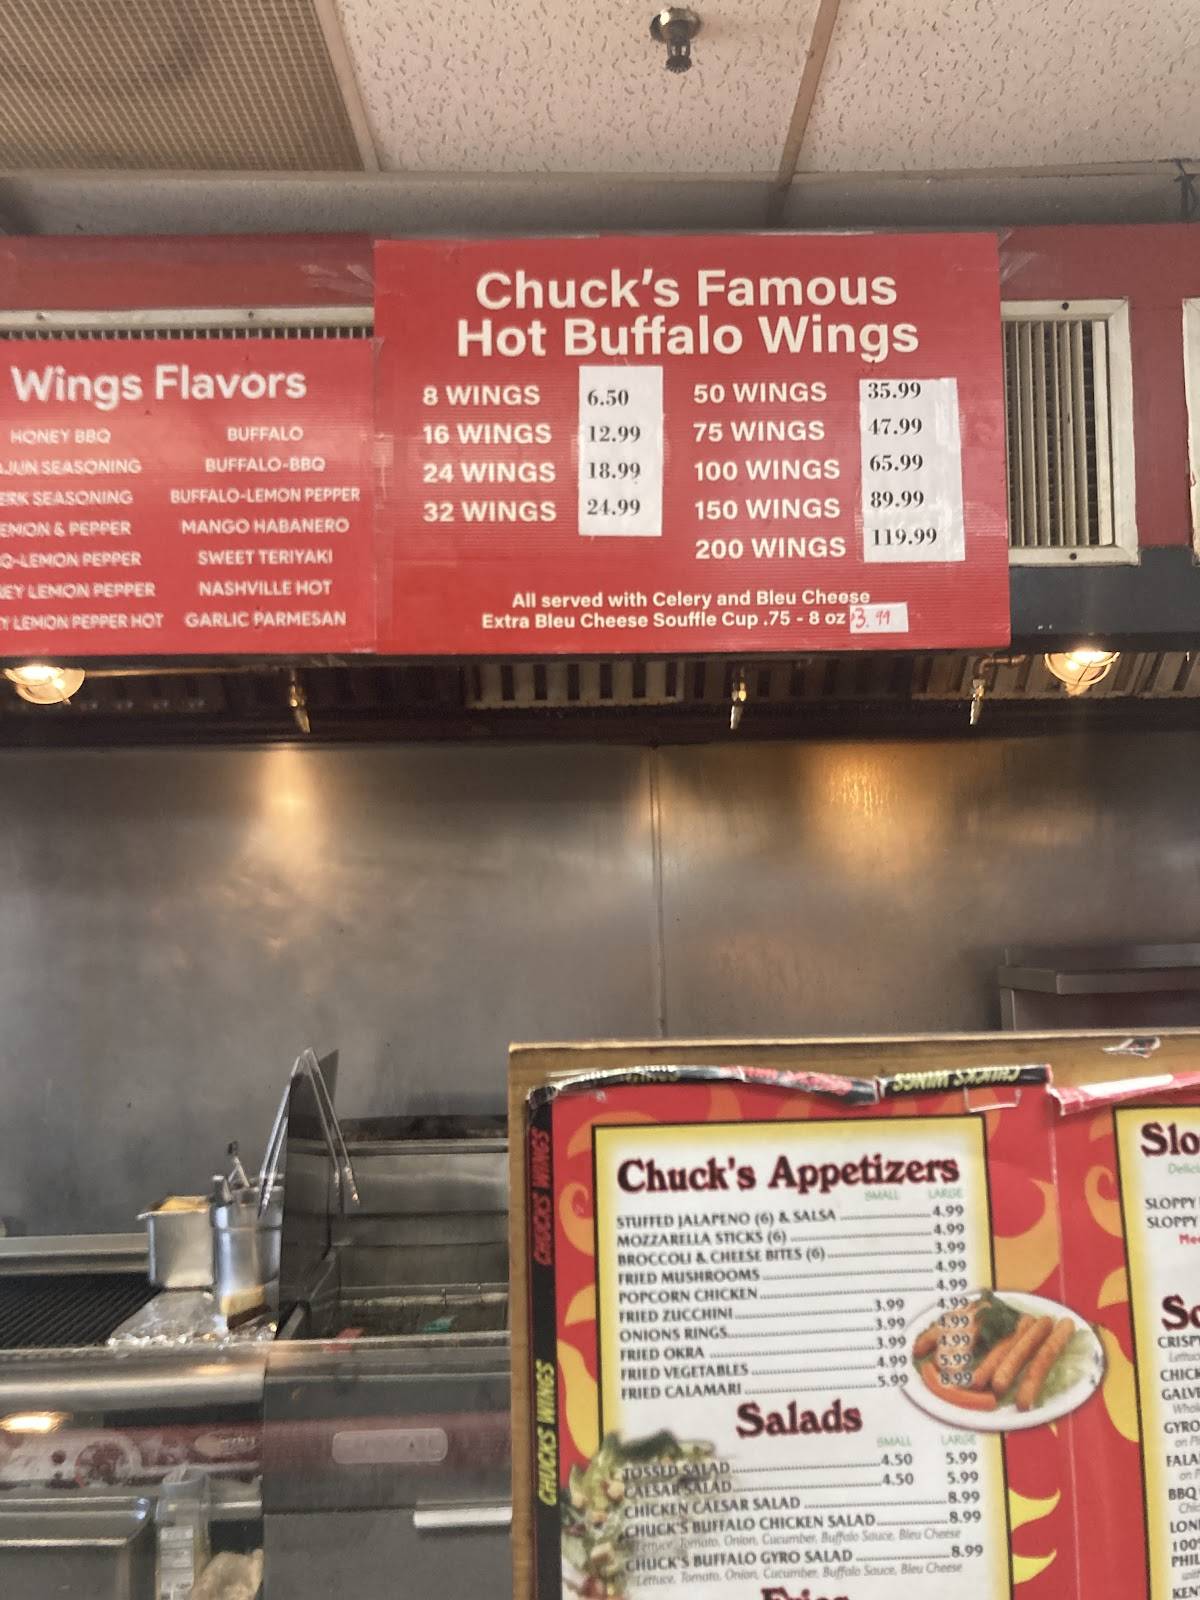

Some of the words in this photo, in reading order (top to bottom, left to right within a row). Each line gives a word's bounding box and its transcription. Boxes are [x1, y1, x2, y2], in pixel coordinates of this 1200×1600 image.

[476, 268, 680, 310] Chuck's
[697, 268, 898, 307] Famous
[457, 318, 547, 357] Hot
[563, 315, 743, 356] Buffalo
[758, 314, 920, 364] Wings
[11, 365, 143, 411] Wings
[155, 364, 307, 400] Flavors
[422, 385, 439, 406] 8
[446, 385, 541, 405] WINGS
[693, 384, 725, 404] 50
[733, 382, 828, 403] WINGS
[867, 381, 922, 399] 35.99
[587, 389, 629, 407] 6.50
[227, 426, 304, 442] BUFFALO
[423, 424, 450, 444] 16
[457, 423, 552, 444] WINGS
[587, 425, 641, 443] 12.99
[693, 422, 723, 442] 75
[731, 420, 825, 441] WINGS
[868, 417, 923, 435] 47.99
[10, 428, 70, 445] HONEY
[74, 428, 112, 444] BBQ
[42, 457, 142, 475] SEASONING
[205, 457, 326, 473] BUFFALO-BBQ
[587, 461, 641, 479] 18.99
[694, 461, 738, 481] 100
[746, 459, 841, 480] WINGS
[869, 453, 924, 472] 65.99
[423, 463, 454, 483] 24
[461, 462, 556, 483] WINGS
[33, 489, 133, 506] SEASONING
[170, 488, 302, 504] BUFFALO-LEMON
[304, 487, 361, 502] PEPPER
[870, 490, 925, 508] 89.99
[423, 502, 454, 522] 32
[461, 501, 557, 522] WINGS
[586, 498, 641, 516] 24.99
[694, 500, 738, 520] 150
[746, 498, 841, 519] WINGS
[54, 521, 65, 537] &
[69, 520, 131, 536] PEPPER
[182, 519, 250, 535] MANGO
[254, 517, 349, 534] HABANERO
[871, 528, 938, 547] 119.99
[198, 550, 254, 566] SWEET
[258, 549, 332, 564] TERIYAKI
[695, 539, 744, 560] 200
[752, 537, 846, 559] WINGS
[82, 550, 142, 567] PEPPER
[28, 582, 90, 599] LEMON
[93, 581, 156, 598] PEPPER
[199, 581, 292, 597] NASHVILLE
[296, 580, 333, 595] HOT
[512, 592, 536, 608] All
[541, 592, 604, 608] served
[608, 591, 648, 607] with
[652, 590, 712, 609] Celery
[717, 590, 751, 606] and
[756, 589, 797, 606] Bleu
[801, 589, 870, 605] Cheese
[13, 613, 68, 631] LEMON
[72, 612, 128, 629] PEPPER
[131, 612, 164, 628] HOT
[185, 611, 249, 628] GARLIC
[254, 611, 347, 627] PARMESAN
[482, 614, 530, 629] Extra
[535, 613, 576, 629] Bleu
[580, 612, 649, 628] Cheese
[653, 611, 717, 627] Souffle
[721, 611, 759, 629] Cup
[763, 611, 791, 626] .75
[808, 610, 820, 625] 8
[825, 613, 846, 625] oz
[616, 1156, 757, 1193] Chuck's
[768, 1152, 960, 1195] Appetizers
[933, 1205, 964, 1217] 4.99
[1145, 1196, 1195, 1210] SLOPPY
[616, 1214, 674, 1228] STUFFED
[678, 1212, 750, 1229] JALAPENO
[755, 1211, 774, 1227] (6)
[779, 1210, 789, 1223] &
[793, 1208, 836, 1222] SALSA
[1147, 1215, 1198, 1229] SLOPPY
[617, 1232, 711, 1247] MOZZARELLA
[716, 1230, 763, 1244] STICKS
[767, 1230, 787, 1246] (6)
[933, 1223, 965, 1236] 4.99
[618, 1251, 691, 1266] BROCCOLI
[696, 1251, 706, 1264] &
[710, 1249, 762, 1264] CHEESE
[766, 1248, 802, 1262] BITES
[806, 1246, 826, 1263] (6)
[935, 1241, 966, 1255] 3.99
[936, 1260, 967, 1273] 4.99
[618, 1271, 657, 1285] FRIED
[661, 1269, 760, 1284] MUSHROOMS
[937, 1278, 968, 1291] 4.99
[618, 1290, 690, 1305] POPCORN
[694, 1287, 757, 1302] CHICKEN
[937, 1297, 969, 1309] 4.99
[875, 1299, 905, 1312] 3.99
[619, 1309, 658, 1324] FRIED
[662, 1307, 733, 1322] ZUCCHINI
[876, 1317, 906, 1330] 3.99
[619, 1328, 680, 1343] ONIONS
[684, 1326, 728, 1340] RINGS
[876, 1336, 906, 1349] 3.99
[620, 1348, 660, 1362] FRIED
[664, 1346, 705, 1360] OKRA
[877, 1354, 908, 1368] 4.99
[621, 1367, 660, 1381] FRIED
[664, 1363, 749, 1379] VEGETABLES
[877, 1374, 909, 1388] 5.99
[536, 1358, 555, 1424] WINGS
[621, 1386, 661, 1400] FRIED
[665, 1382, 742, 1398] CALAMARI
[736, 1398, 863, 1438] Salads
[537, 1425, 557, 1505] CHUCKS
[881, 1453, 913, 1466] 4.50
[946, 1451, 978, 1465] 5.99
[624, 1466, 678, 1481] TOSSED
[682, 1461, 730, 1476] SALAD
[882, 1473, 914, 1486] 4.50
[947, 1471, 979, 1485] 5.99
[624, 1484, 680, 1499] CAESAR
[684, 1480, 732, 1495] SALAD
[948, 1491, 980, 1504] 8.99
[1168, 1487, 1198, 1501] BBQ
[624, 1502, 688, 1518] CHICKEN
[692, 1499, 749, 1514] CAESAR
[753, 1496, 800, 1510] SALAD
[692, 1518, 755, 1533] BUFFALO
[759, 1515, 823, 1530] CHICKEN
[827, 1513, 876, 1528] SALAD
[949, 1510, 981, 1524] 8.99
[693, 1553, 757, 1568] BUFFALO
[760, 1550, 800, 1565] GYRO
[804, 1549, 852, 1563] SALAD
[951, 1545, 983, 1558] 8.99
